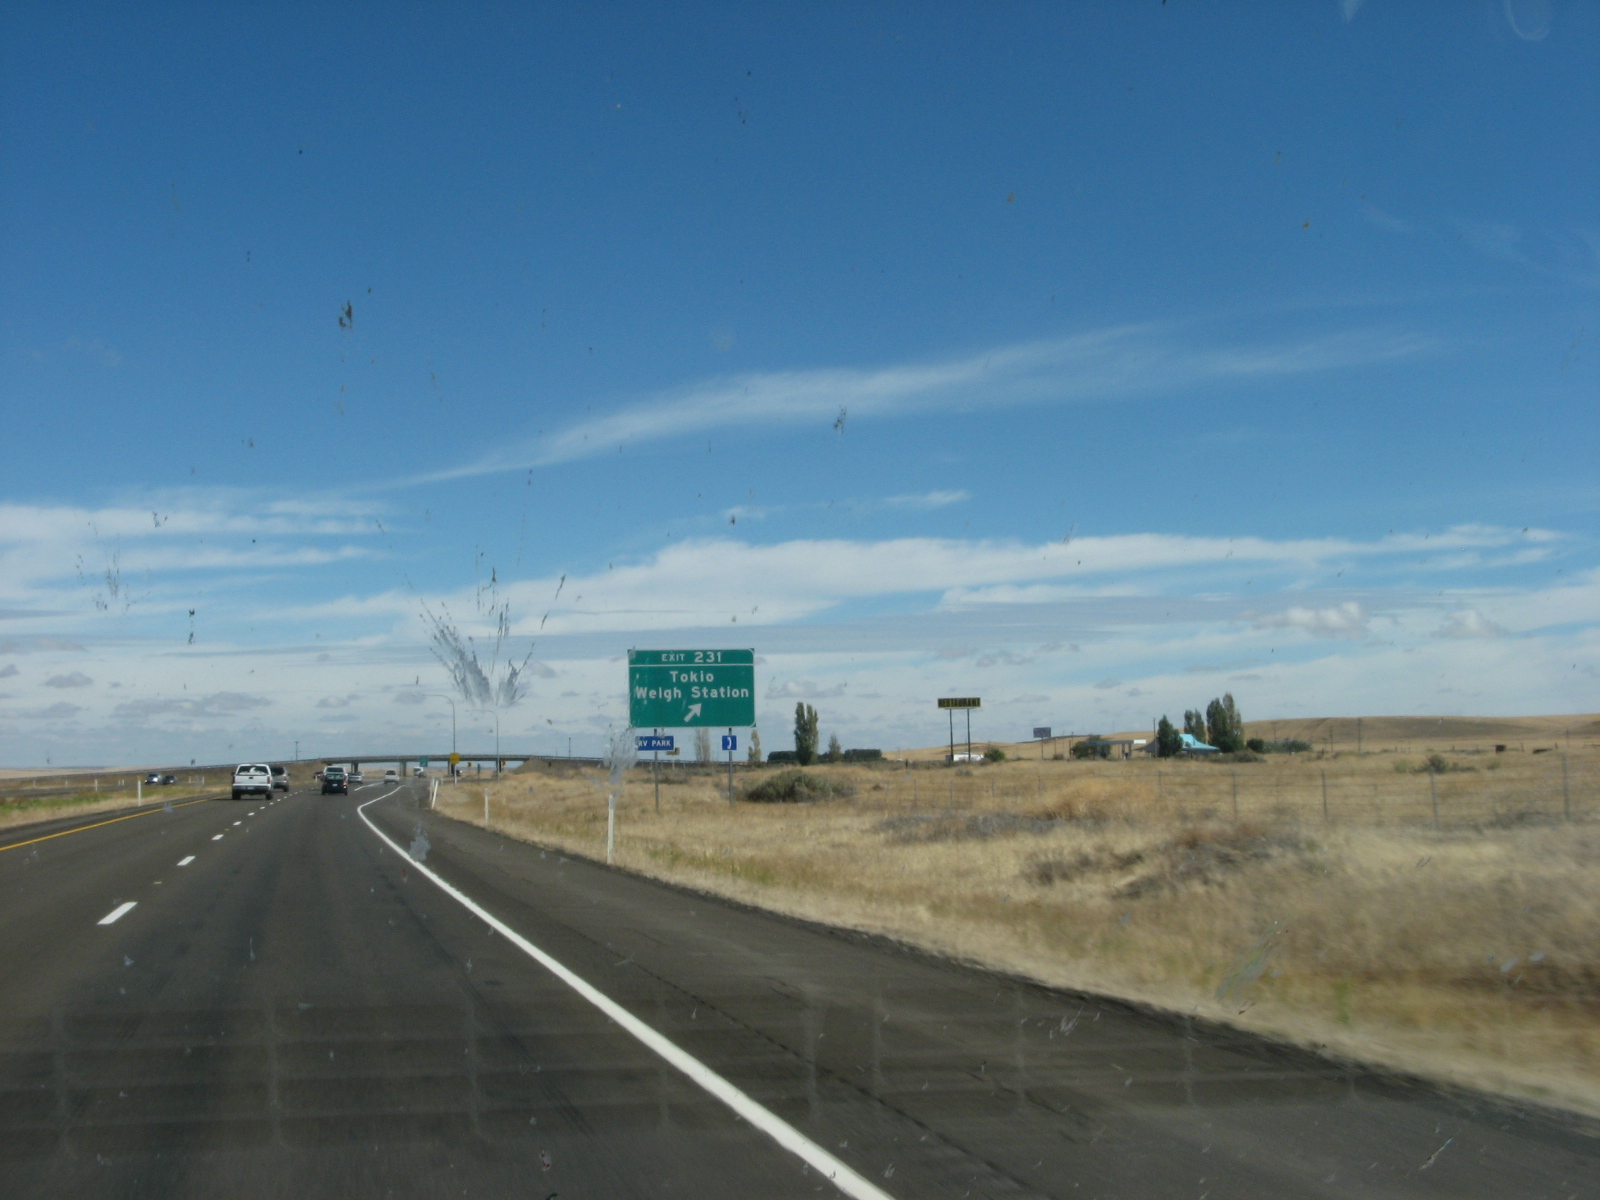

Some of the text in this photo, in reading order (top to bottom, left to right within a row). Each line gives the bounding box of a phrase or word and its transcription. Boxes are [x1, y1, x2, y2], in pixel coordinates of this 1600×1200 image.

[661, 651, 722, 663] EXIT 231
[669, 671, 714, 682] Tokio
[635, 686, 749, 702] Weigh Station
